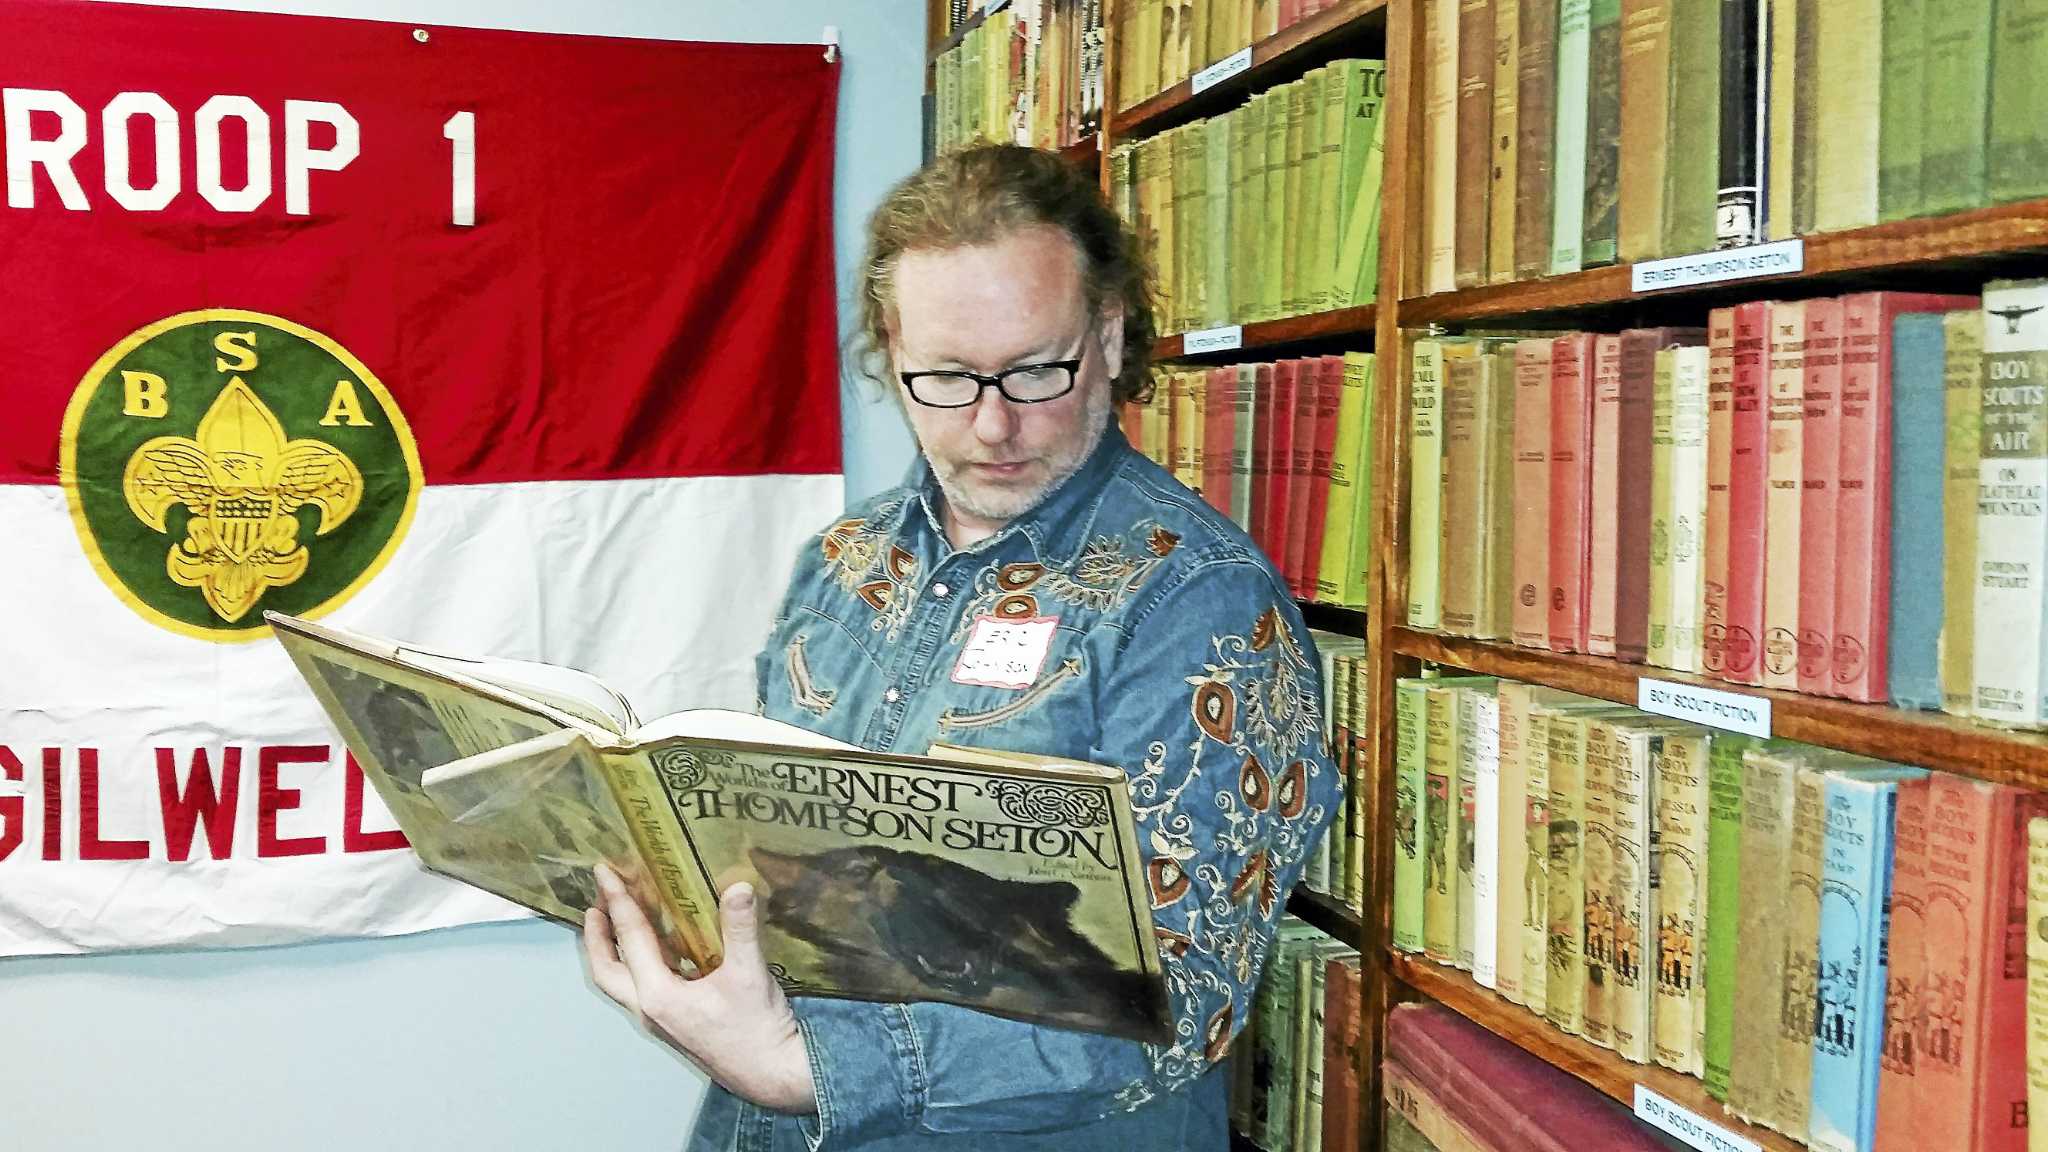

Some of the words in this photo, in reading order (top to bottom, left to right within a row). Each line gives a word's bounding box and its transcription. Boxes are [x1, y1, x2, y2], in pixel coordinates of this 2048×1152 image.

[1360, 68, 1385, 98] TO
[1353, 102, 1376, 118] AT
[442, 111, 476, 226] 1
[1642, 267, 1683, 283] ERNEST
[1685, 258, 1747, 278] THOMPSON
[1750, 252, 1791, 269] SETON
[1415, 355, 1432, 367] THE
[1990, 360, 2030, 380] BOY
[121, 370, 169, 419] B
[214, 331, 258, 372] S
[318, 380, 373, 427] A
[1983, 386, 2045, 406] SCOUTS
[1991, 432, 2030, 450] AIR
[1650, 689, 1671, 703] BOY
[1674, 693, 1712, 714] SCOUT
[1713, 702, 1758, 723] FICTION
[735, 763, 771, 778] The
[1662, 757, 1690, 774] BOY
[708, 771, 769, 788] Worlds
[771, 779, 788, 791] of
[771, 762, 983, 812] ERNEST
[677, 783, 936, 843] THOMPSON
[941, 817, 1119, 870] SETON
[1826, 810, 1857, 828] BOY
[1645, 1098, 1666, 1119] BOY
[1669, 1110, 1704, 1138] SCOUT
